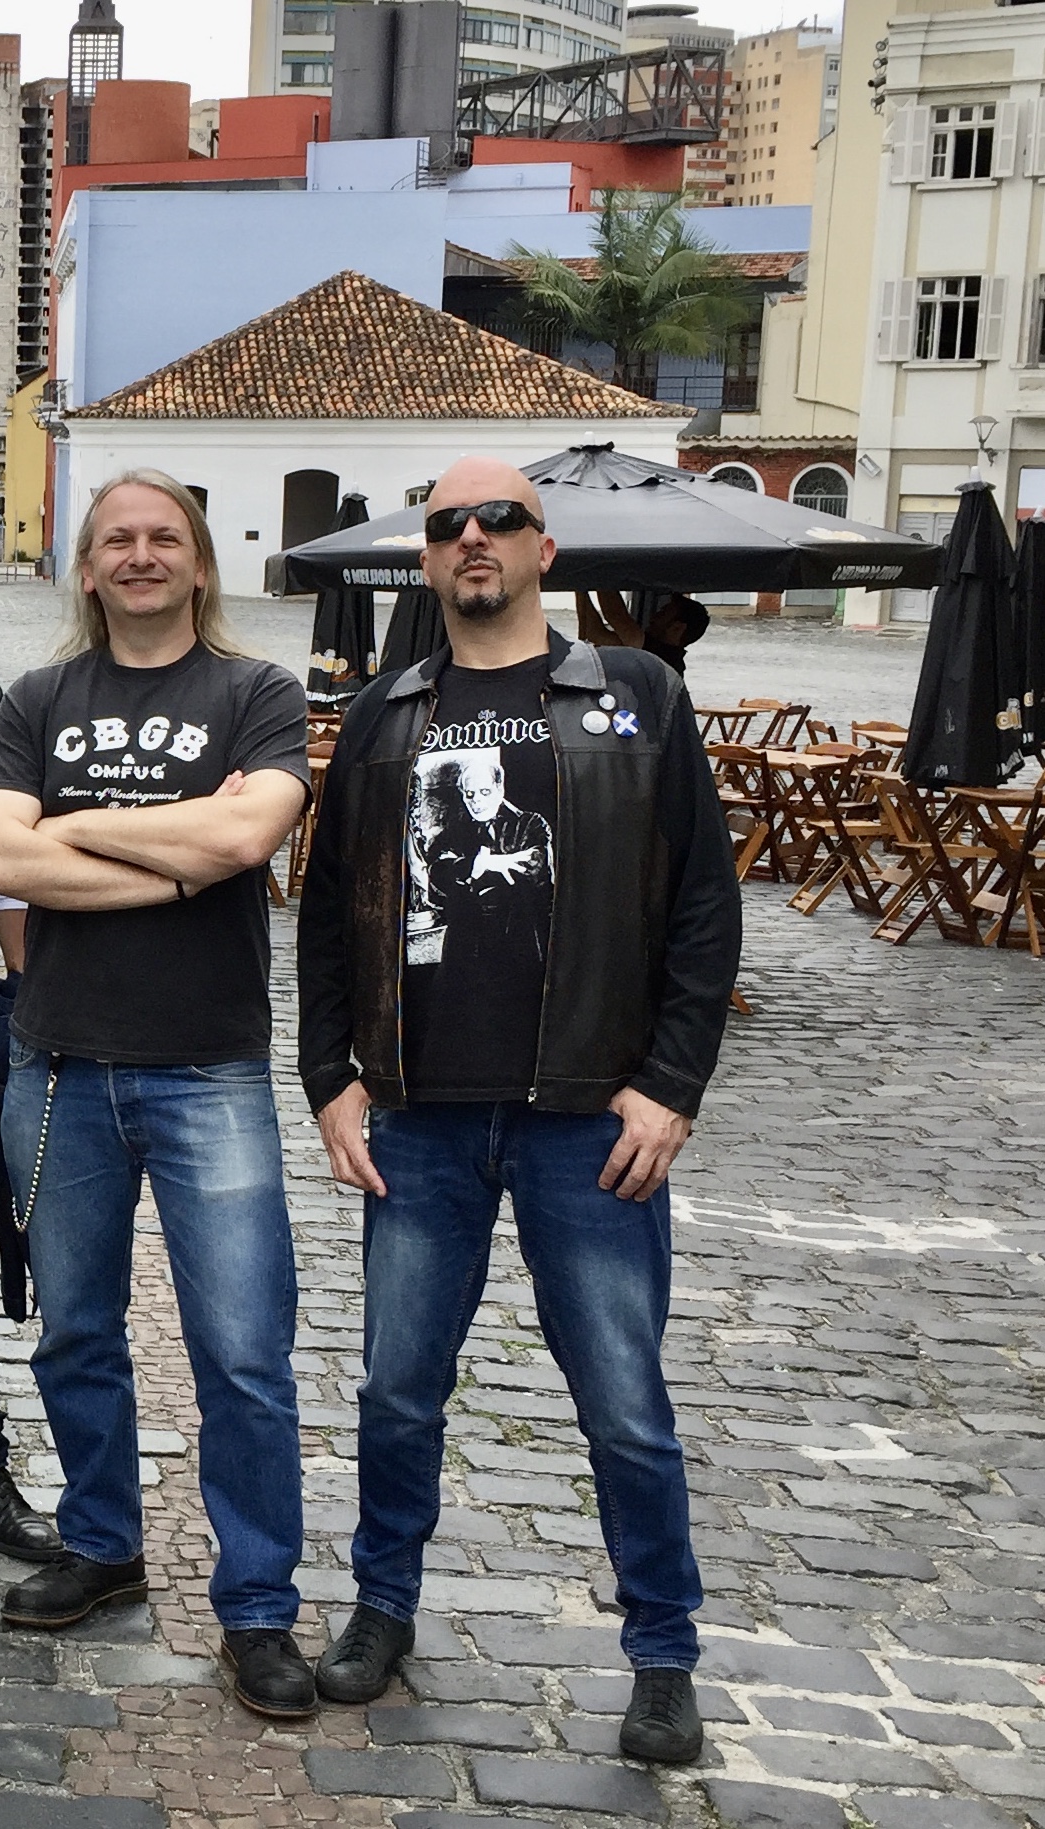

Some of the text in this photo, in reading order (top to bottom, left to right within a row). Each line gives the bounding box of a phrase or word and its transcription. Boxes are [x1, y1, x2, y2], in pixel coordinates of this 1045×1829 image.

[342, 568, 352, 585] O
[351, 568, 393, 585] MELHOR
[393, 568, 408, 586] DO
[53, 716, 209, 763] CBGB
[87, 763, 165, 780] OMFUG
[58, 786, 183, 804] Home of Underground
